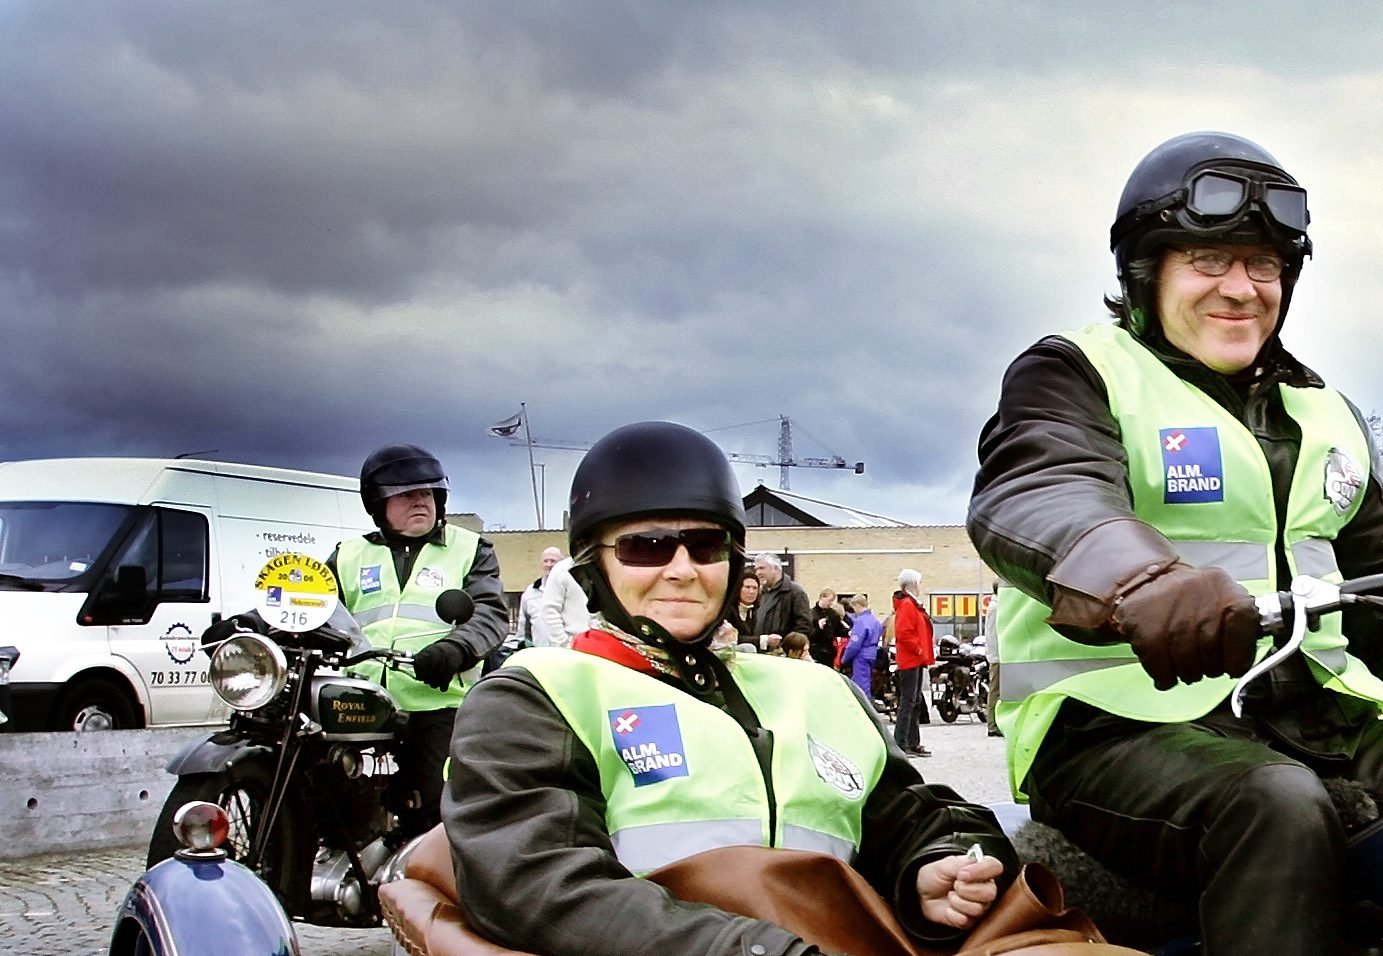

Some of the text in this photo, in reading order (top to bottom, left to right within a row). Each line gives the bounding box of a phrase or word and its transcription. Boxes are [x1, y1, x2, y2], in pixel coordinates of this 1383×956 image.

[1167, 464, 1203, 478] ALM.
[1168, 477, 1221, 493] BRAND
[263, 532, 316, 545] reservedele
[255, 554, 301, 590] SKAGEN
[280, 611, 308, 626] 216
[151, 671, 165, 685] 70
[168, 671, 181, 685] 33
[184, 671, 198, 685] 77
[332, 700, 367, 712] ROYAL
[337, 712, 376, 724] ENFIELD
[628, 752, 683, 775] BRAND
